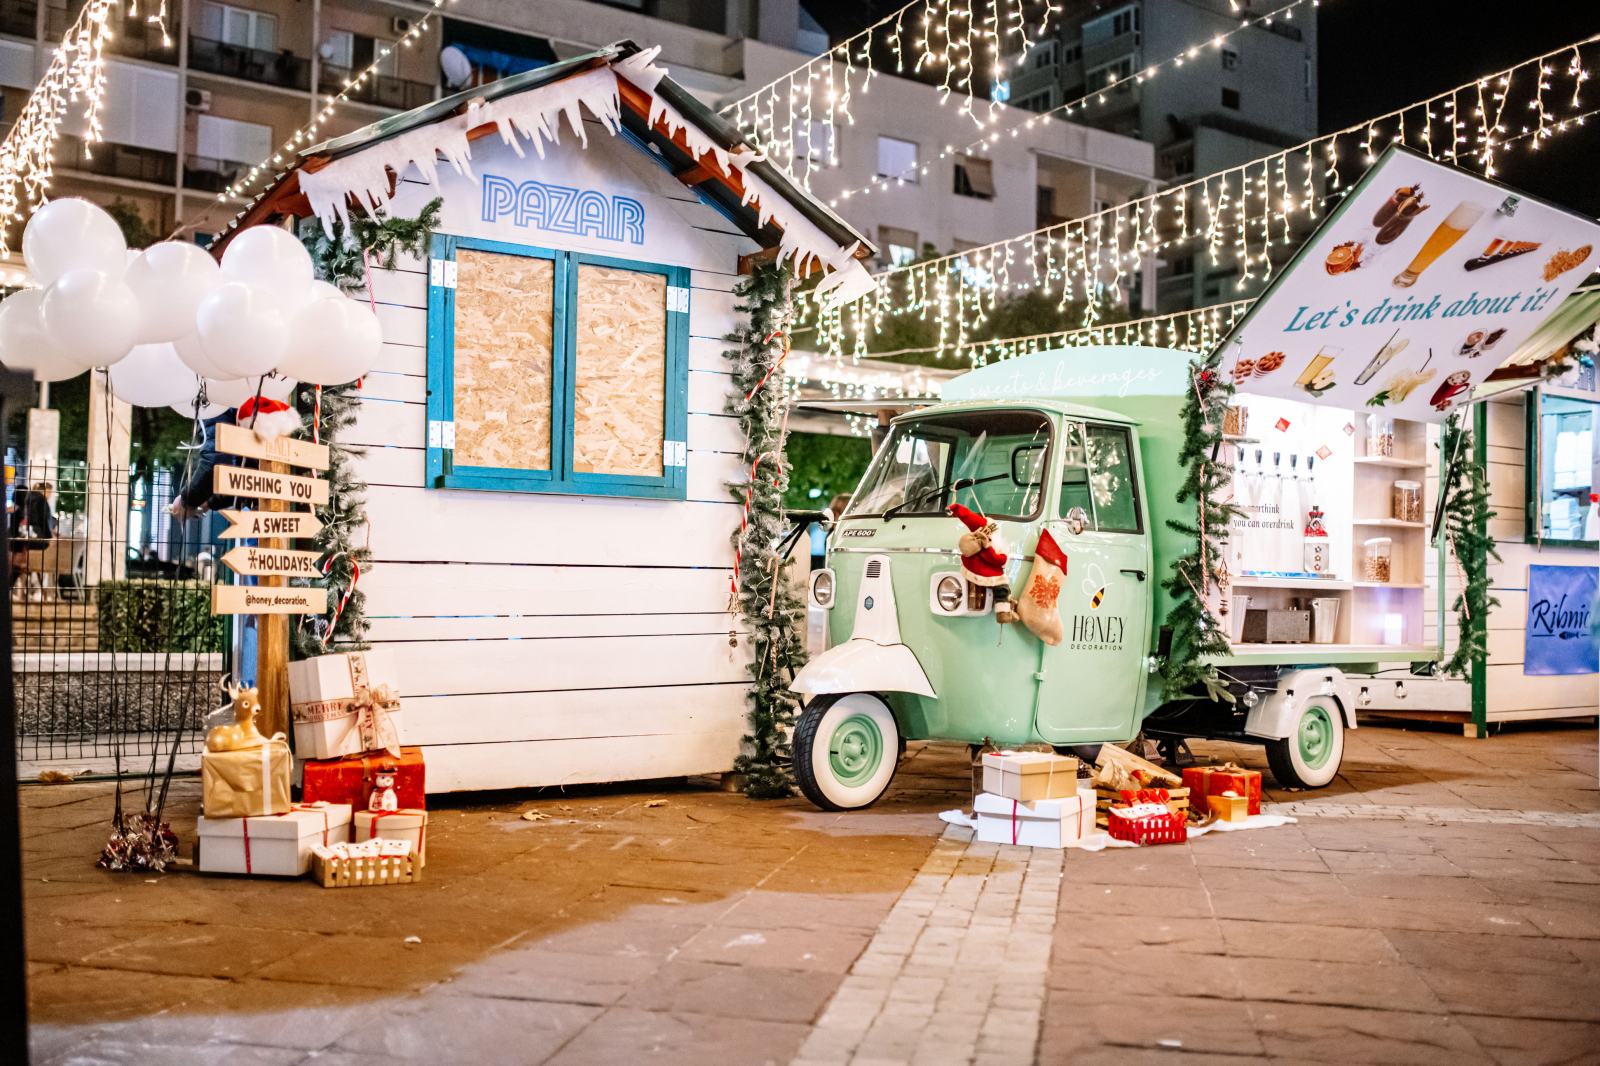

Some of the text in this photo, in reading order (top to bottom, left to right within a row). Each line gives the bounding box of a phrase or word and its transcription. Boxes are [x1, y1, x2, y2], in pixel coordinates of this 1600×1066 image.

[482, 173, 645, 245] PAZAR
[1361, 294, 1441, 326] drink
[1442, 291, 1521, 319] about
[1520, 287, 1559, 313] it!
[1053, 359, 1164, 398] beverages
[229, 473, 312, 499] WISHING YOU
[252, 518, 300, 533] A SWEET
[1233, 519, 1294, 529] you can overdrink
[258, 554, 312, 573] HOLIDAYS!
[1072, 615, 1128, 643] HONEY
[307, 702, 342, 714] MERRY
